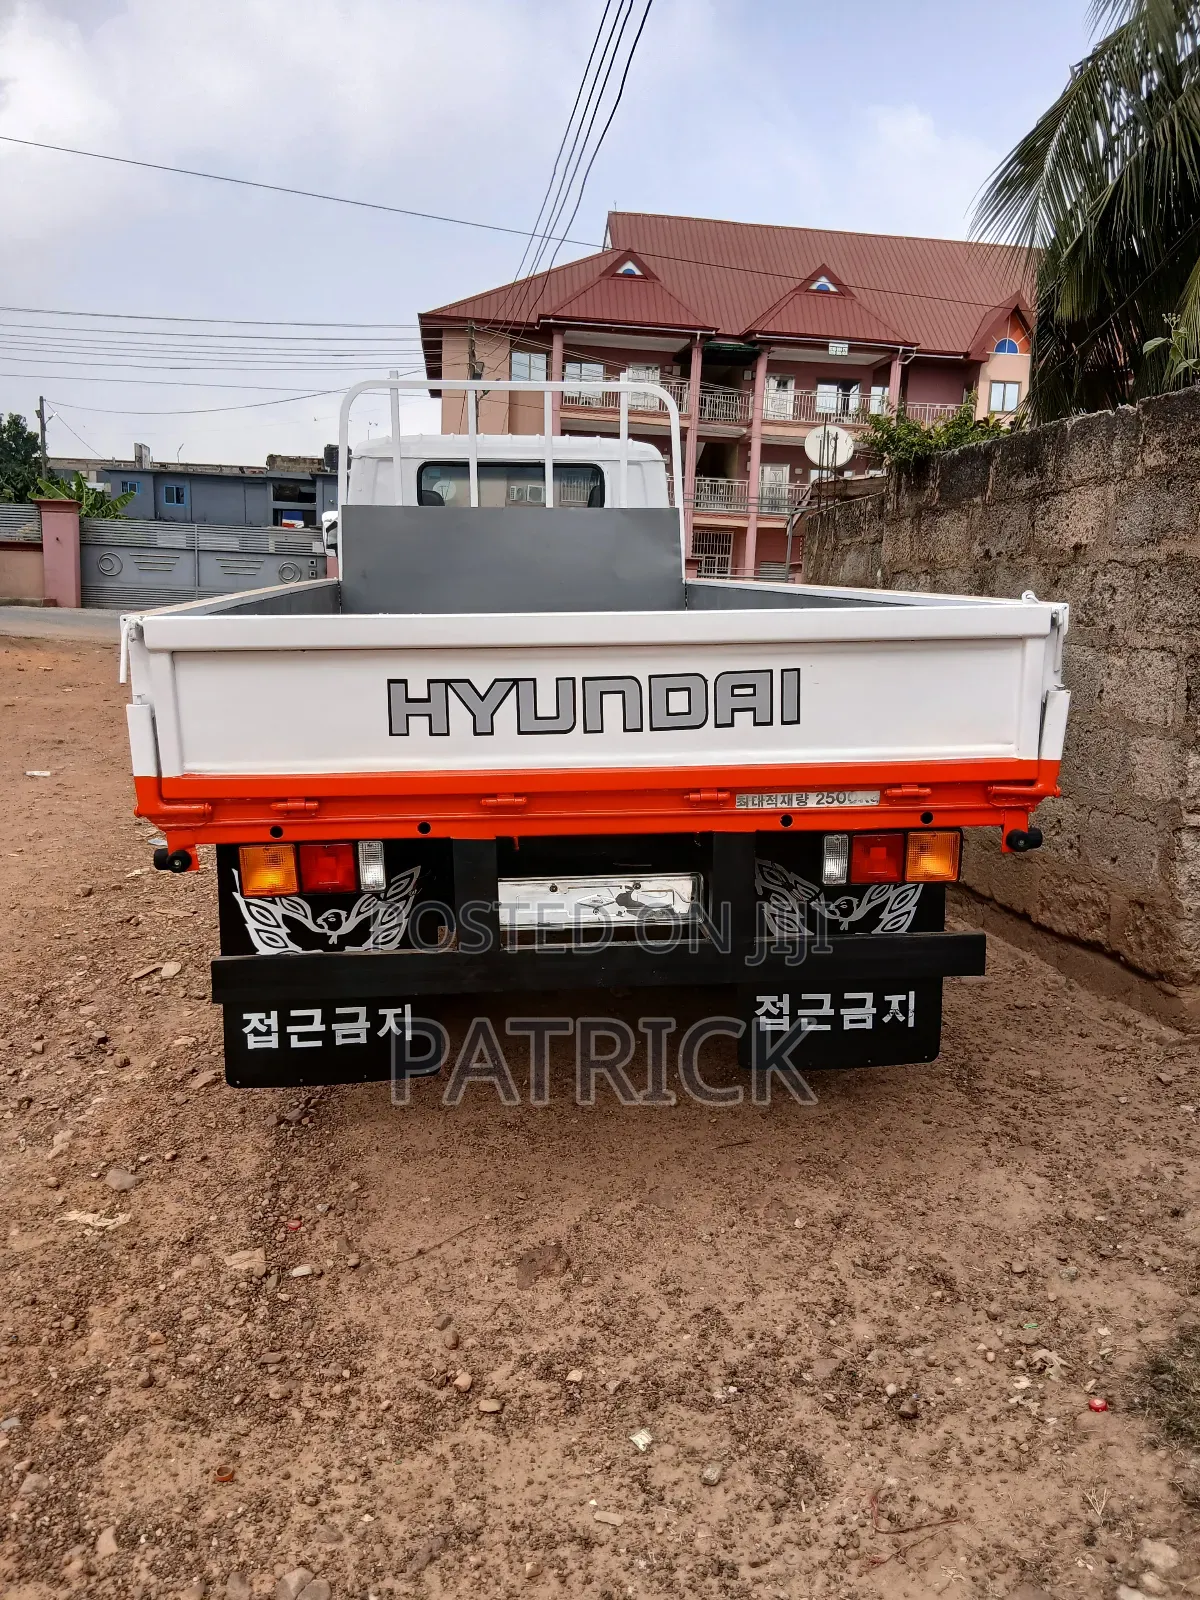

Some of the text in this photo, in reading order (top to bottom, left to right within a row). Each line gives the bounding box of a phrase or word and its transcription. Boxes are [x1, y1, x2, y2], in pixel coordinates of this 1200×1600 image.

[387, 668, 801, 736] HYUNDAI
[736, 792, 809, 808] 최대적재량
[242, 1003, 412, 1050] 접근금지
[754, 990, 915, 1032] 접근금지
